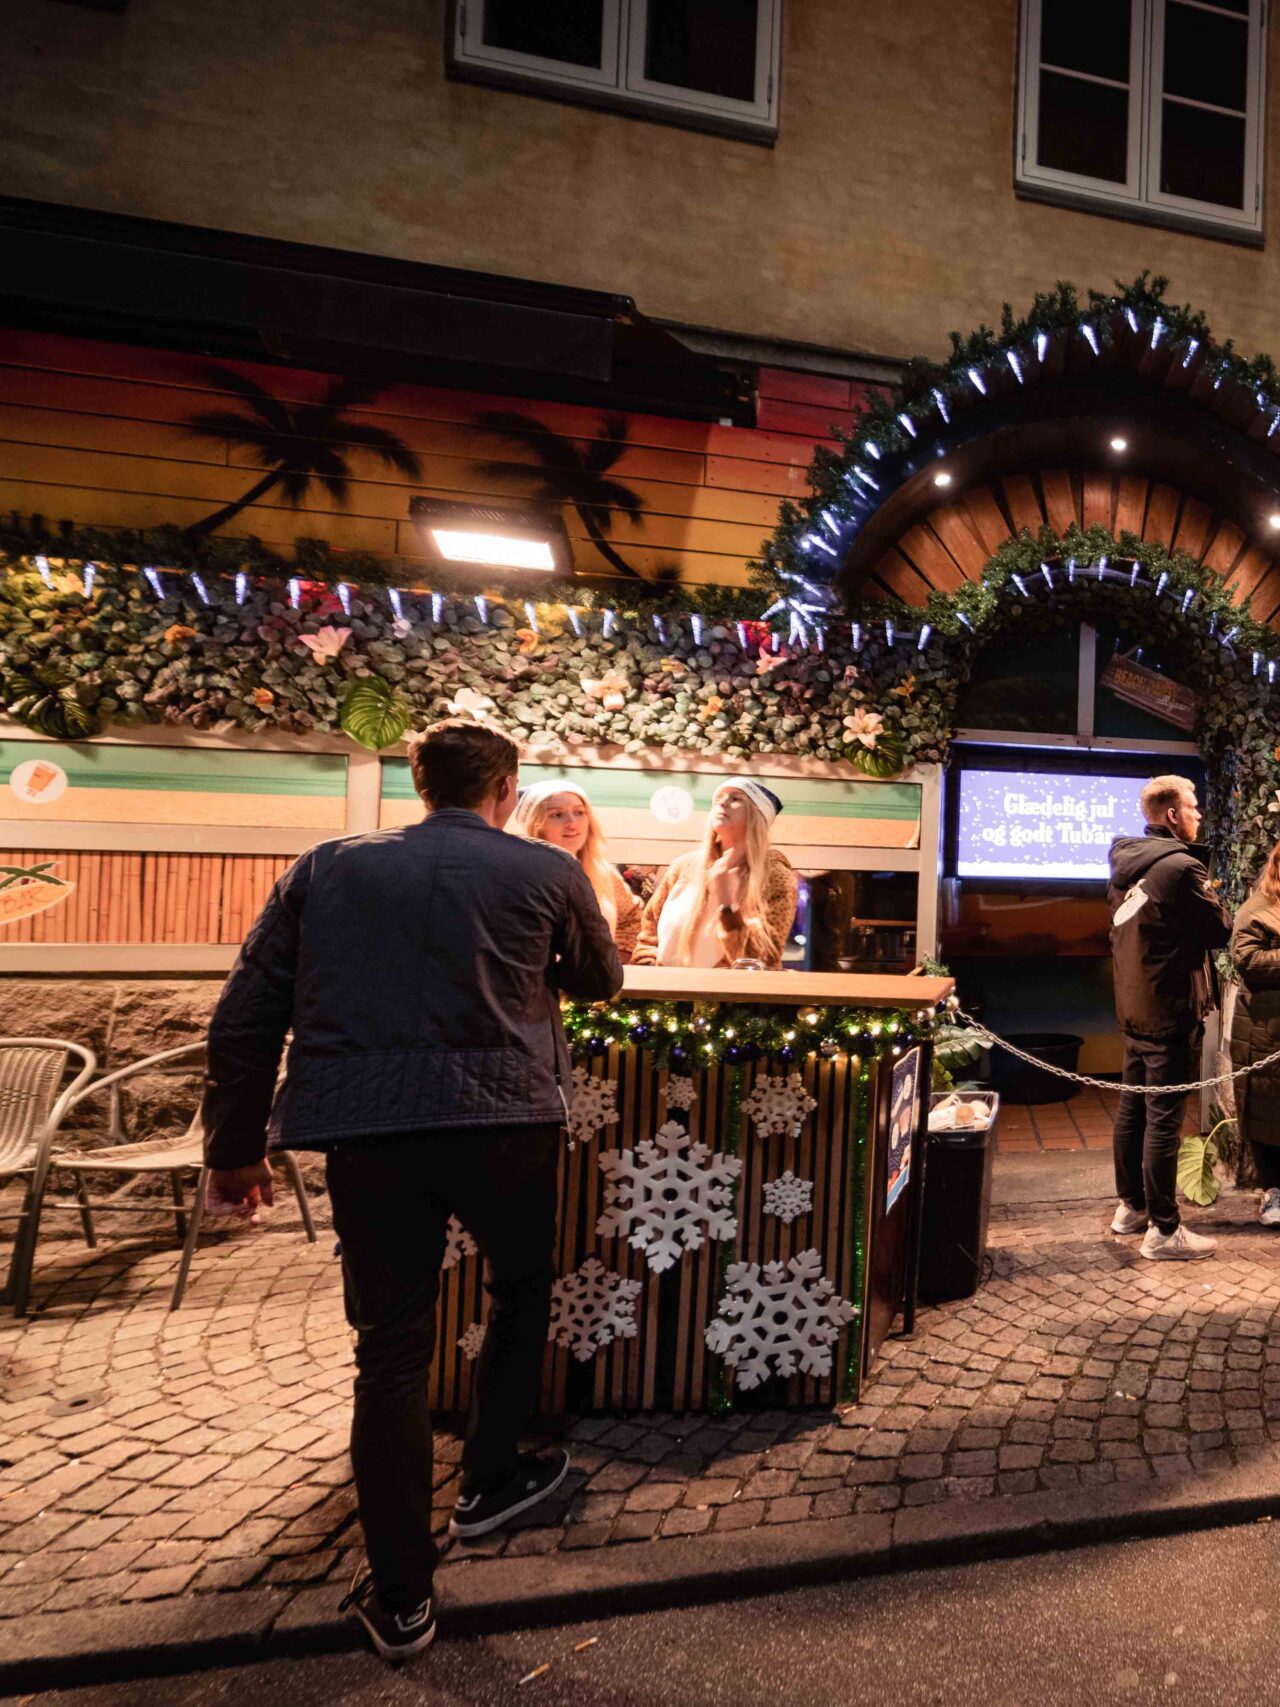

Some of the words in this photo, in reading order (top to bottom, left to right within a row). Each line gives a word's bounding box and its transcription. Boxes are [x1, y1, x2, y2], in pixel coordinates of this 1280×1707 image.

[1004, 793, 1087, 820] Glædelig
[1090, 796, 1116, 822] jul
[983, 826, 1007, 847] og
[1010, 823, 1053, 847] godt
